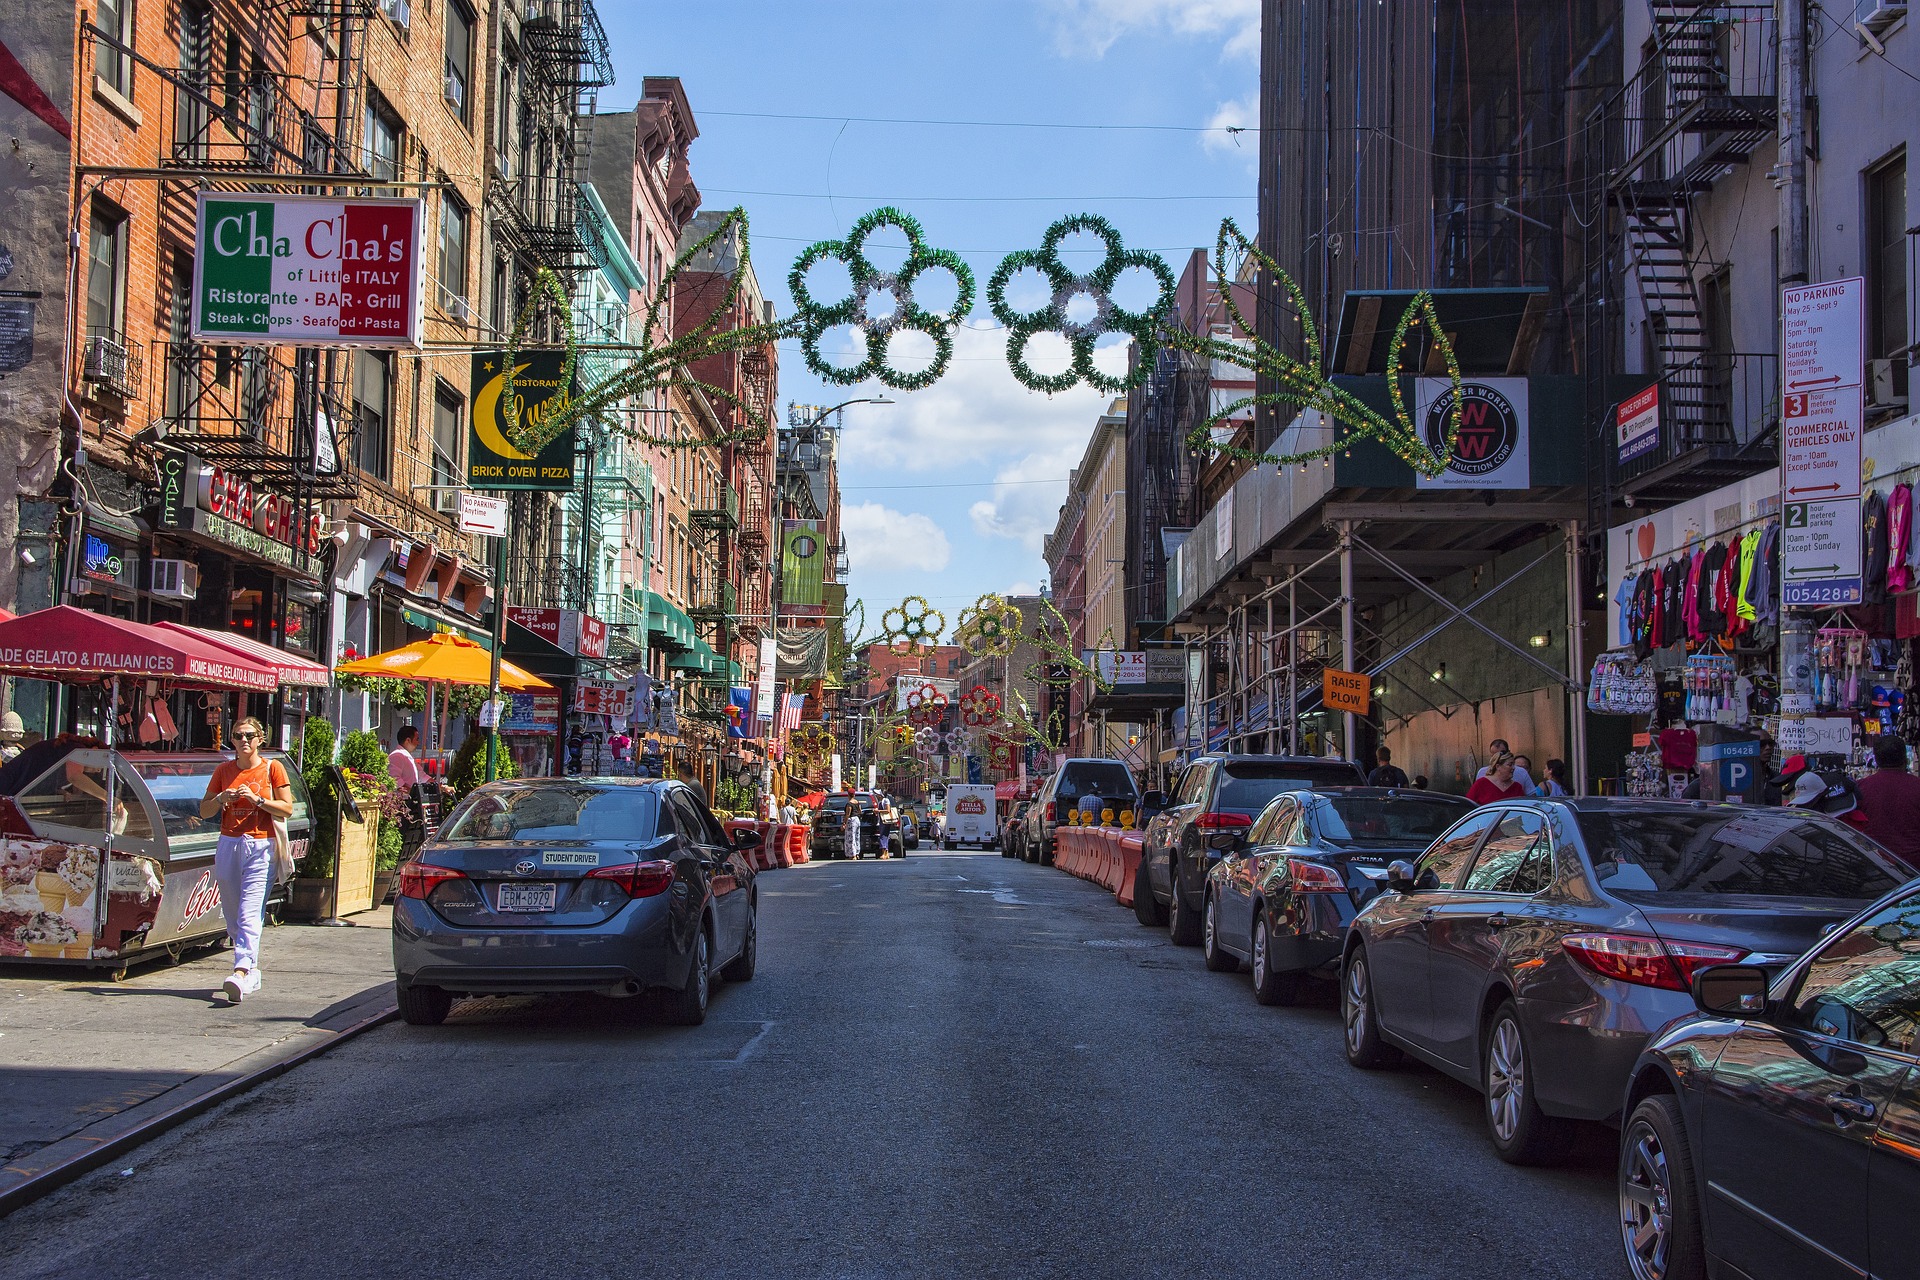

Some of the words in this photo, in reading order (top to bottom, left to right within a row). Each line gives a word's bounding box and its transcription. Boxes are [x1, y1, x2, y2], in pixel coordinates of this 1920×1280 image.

[213, 210, 293, 258] Cha
[304, 213, 404, 262] Cha's
[287, 268, 303, 281] of
[309, 269, 350, 284] Little
[356, 271, 400, 285] ITALY
[209, 288, 298, 305] Ristorante
[315, 292, 353, 308] BAR
[367, 294, 401, 309] Grill
[1788, 293, 1800, 304] NO
[1803, 286, 1845, 301] PARKING
[1787, 307, 1800, 315] May
[1802, 305, 1810, 313] 25
[1816, 303, 1831, 311] Sept
[208, 312, 244, 324] Steak
[252, 313, 293, 327] Chops
[303, 316, 356, 328] Seafood
[365, 317, 400, 329] Pasta
[1787, 319, 1808, 328] Friday
[1787, 329, 1801, 338] 5pm
[1808, 326, 1822, 335] 11pm
[1787, 339, 1817, 350] Saturday
[1787, 349, 1812, 358] Sunday
[1787, 358, 1815, 368] Holidays
[1787, 368, 1802, 376] 11am
[1808, 366, 1823, 375] 11pm
[1433, 387, 1474, 415] WONER
[1478, 388, 1511, 415] WORKS
[1620, 403, 1633, 418] SPACE
[1633, 398, 1641, 411] FOR
[1641, 392, 1653, 407] RENT
[1789, 395, 1802, 416] 3
[1810, 399, 1837, 408] metered
[1810, 407, 1833, 416] parking
[1788, 420, 1849, 436] COMMERCIAL
[1788, 434, 1829, 448] VEHICLES
[1832, 431, 1855, 443] ONLY
[1434, 444, 1493, 472] COTRUCTION
[1493, 444, 1512, 463] CORP
[1788, 454, 1802, 462] 7am
[1809, 451, 1827, 459] 10am
[472, 465, 504, 477] BRICK
[508, 466, 536, 478] OVEN
[541, 467, 570, 478] PIZZA
[1788, 462, 1810, 471] Except
[1813, 460, 1838, 469] Sunday
[210, 466, 253, 529] CHA
[464, 498, 472, 507] NO
[473, 499, 498, 510] PARKING
[464, 507, 487, 518] Anytime
[1789, 505, 1802, 526] 2
[1809, 511, 1836, 519] metered
[1809, 519, 1833, 528] parking
[1787, 534, 1804, 543] 10am
[1811, 533, 1829, 541] 10pm
[1786, 543, 1811, 553] Except
[1814, 542, 1841, 551] Sunday
[1786, 588, 1841, 602] 105428
[526, 614, 538, 622] $4
[541, 622, 557, 630] $10
[25, 650, 77, 665] GELATO
[81, 652, 89, 666] &
[93, 652, 141, 669] ITALIAN
[145, 655, 174, 670] ICES
[190, 659, 207, 675] HOME
[207, 662, 223, 677] MADE
[223, 664, 243, 680] GELATO
[243, 668, 247, 682] &
[247, 670, 265, 686] ITALIAN
[265, 673, 276, 687] ICES
[591, 681, 615, 689] HATS
[1331, 676, 1361, 690] RAISE
[578, 688, 585, 698] 1
[599, 689, 618, 701] $4
[1331, 691, 1360, 705] PLOW
[1609, 691, 1629, 702] NEW
[1631, 692, 1656, 703] YORK
[575, 700, 586, 711] 4
[598, 701, 624, 715] $10
[1805, 727, 1819, 745] 3
[1837, 727, 1850, 743] 10
[1723, 747, 1753, 755] 105428
[1730, 763, 1747, 788] P
[545, 853, 574, 864] STUDENT
[574, 854, 597, 864] DRIVER
[115, 866, 143, 876] Water
